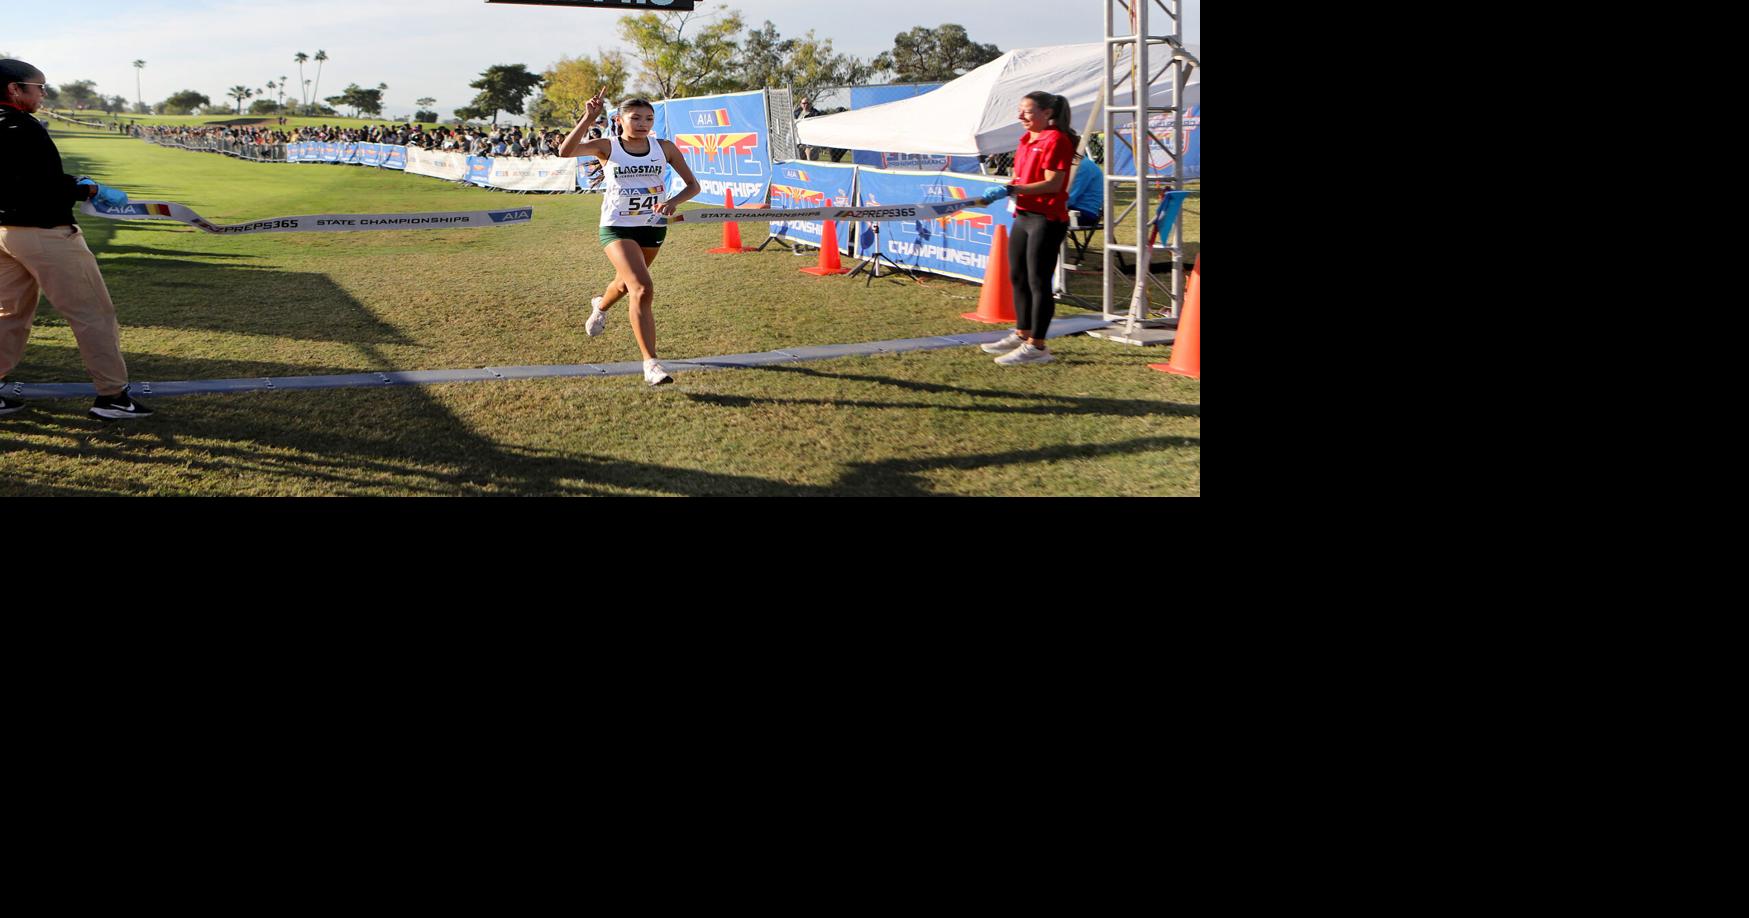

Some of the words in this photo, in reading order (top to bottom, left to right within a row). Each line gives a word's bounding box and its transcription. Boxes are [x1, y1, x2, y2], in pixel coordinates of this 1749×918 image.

[697, 113, 713, 125] AIA
[107, 204, 137, 214] AIA
[628, 196, 658, 210] 541
[360, 216, 470, 225] CHAMPIONSHIPS
[503, 210, 529, 221] AIA
[735, 210, 821, 218] CHAMPIONSHIPS
[844, 208, 916, 218] AZPREPS365
[888, 240, 990, 269] CHAMPIONSHI
